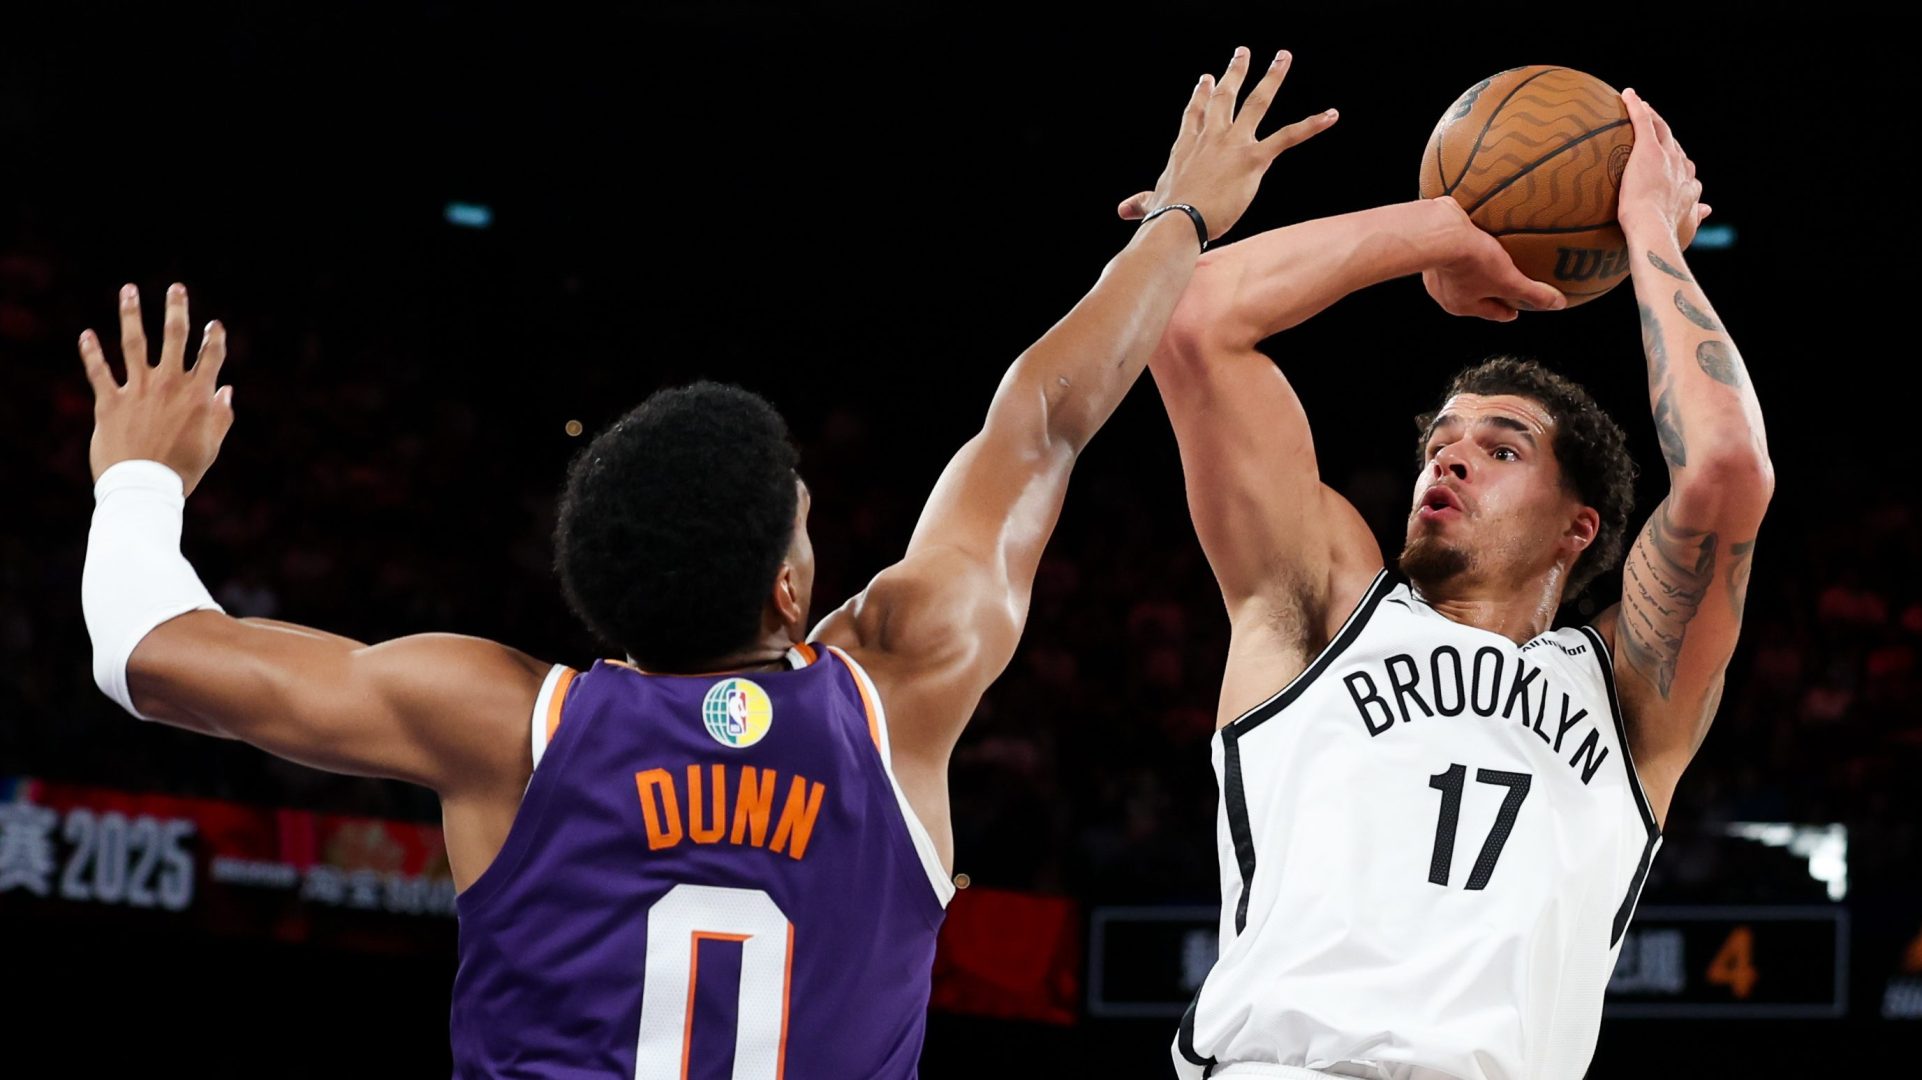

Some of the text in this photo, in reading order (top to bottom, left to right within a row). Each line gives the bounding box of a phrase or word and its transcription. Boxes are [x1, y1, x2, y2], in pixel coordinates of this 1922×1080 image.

[1553, 247, 1630, 281] Wil
[1522, 640, 1541, 653] All
[1342, 645, 1609, 786] BROOKLYN
[635, 764, 826, 860] DUNN
[1428, 763, 1532, 890] 17
[634, 883, 795, 1080] 0
[1706, 927, 1758, 998] 4
